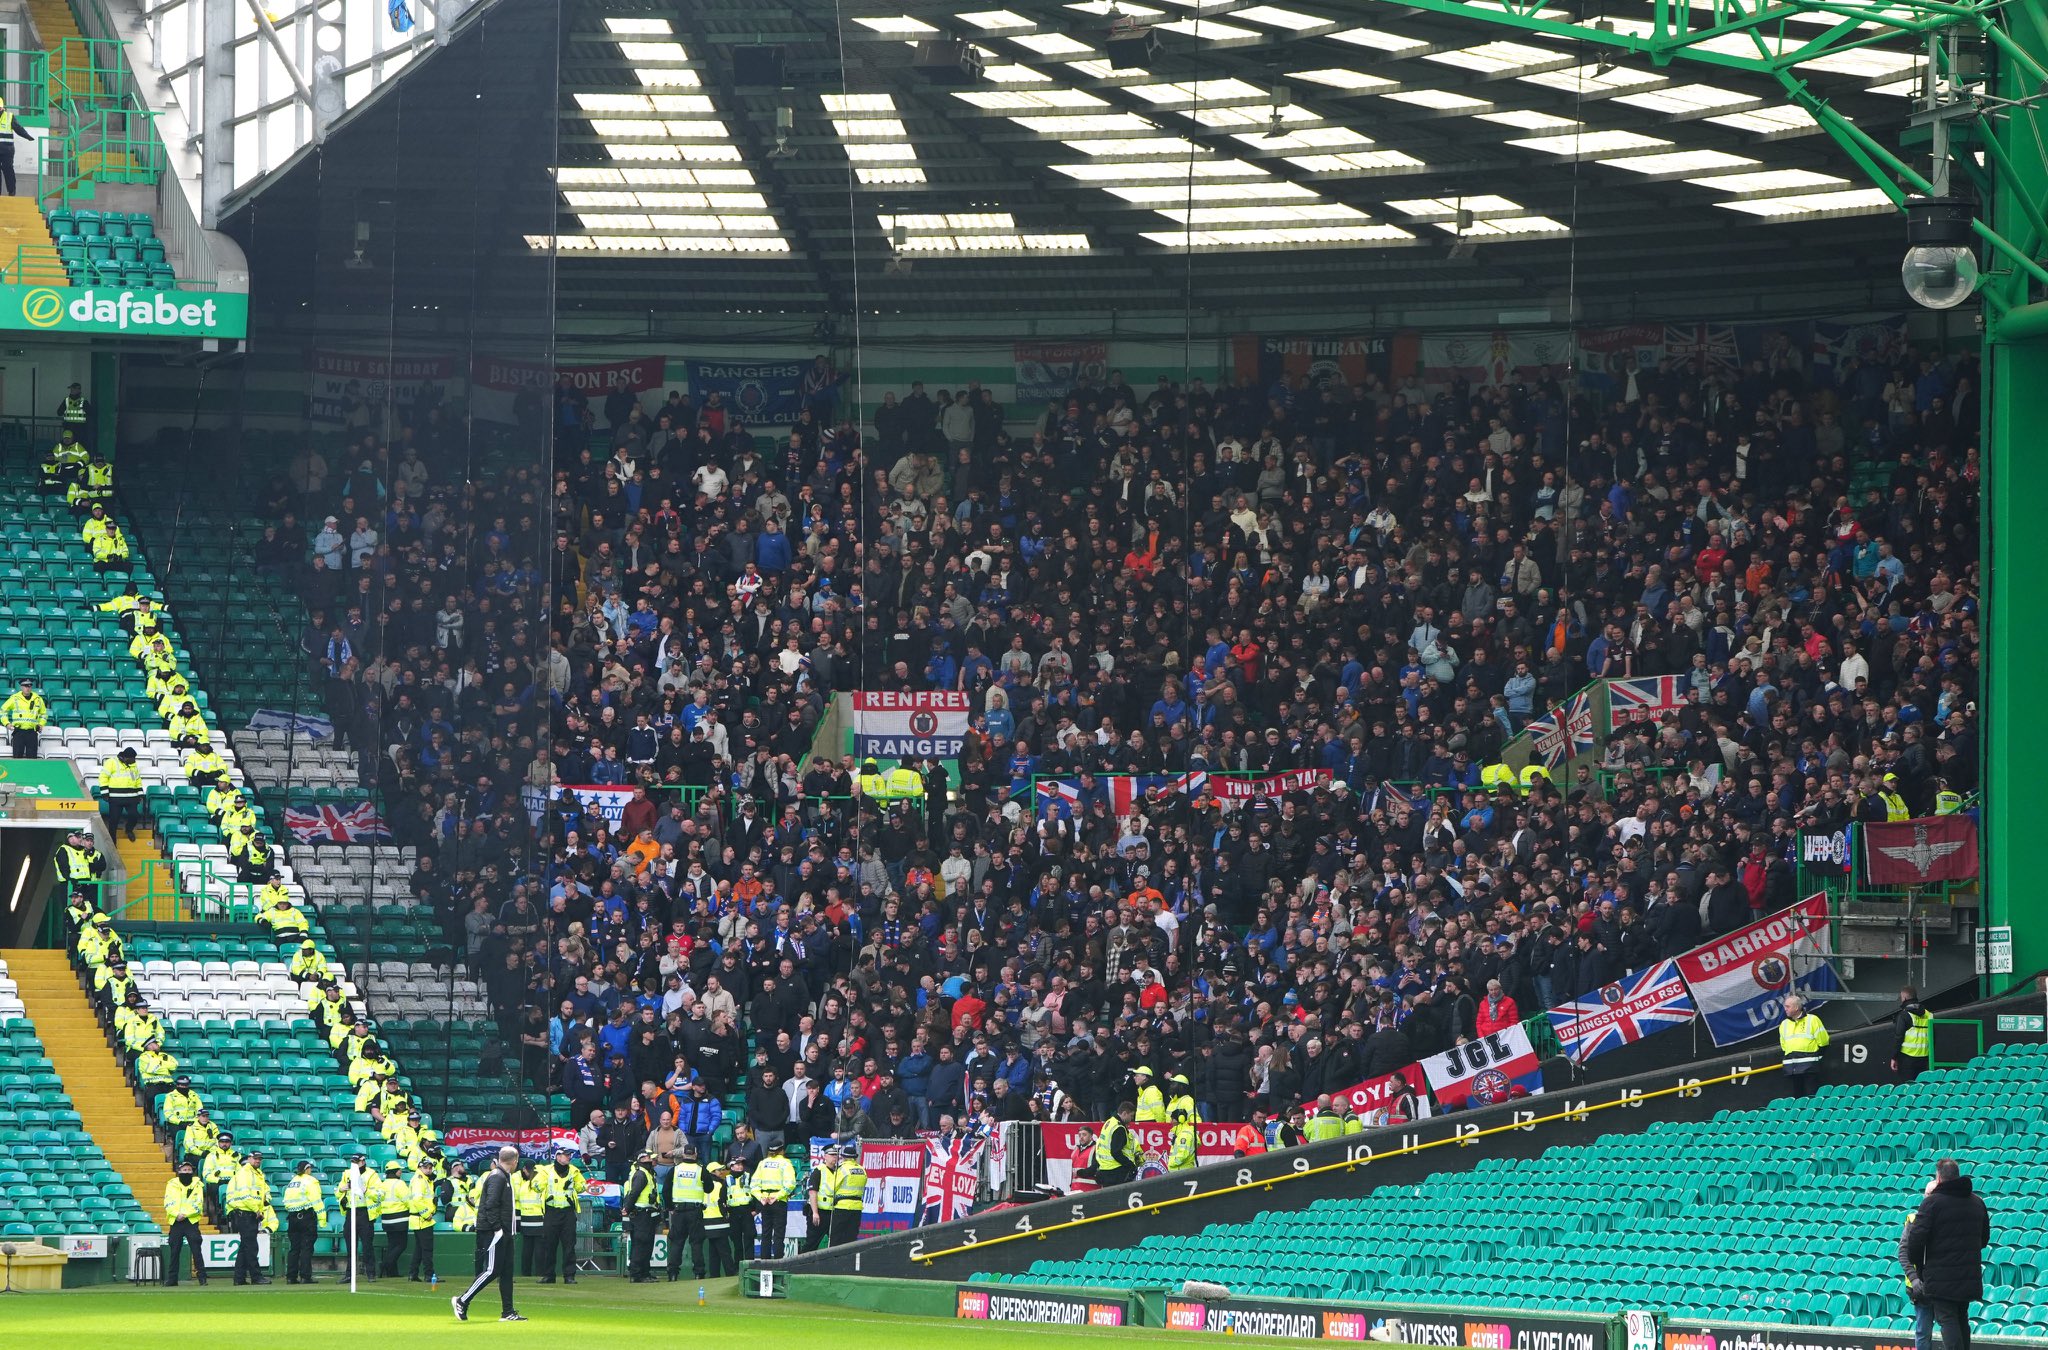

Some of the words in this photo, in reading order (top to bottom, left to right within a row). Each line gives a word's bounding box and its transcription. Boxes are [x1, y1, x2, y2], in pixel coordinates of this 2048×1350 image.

[69, 290, 217, 329] dafabet
[1265, 339, 1386, 356] SOUTHBANK
[318, 357, 360, 373] EVERY
[367, 361, 440, 376] SATURDAY
[698, 365, 800, 379] RANGERS
[867, 739, 964, 755] RANGER
[1698, 908, 1811, 973] BARROW
[1558, 1004, 1633, 1040] UDDINGSTON
[1634, 995, 1657, 1011] No1
[1658, 984, 1682, 1000] RSC
[1445, 1032, 1514, 1079] JGL
[1844, 1044, 1868, 1064] 19
[1730, 1066, 1752, 1085] 17
[1678, 1078, 1702, 1098] 16
[1621, 1088, 1644, 1108] 15
[1565, 1100, 1589, 1122] 14
[1513, 1111, 1536, 1132] 13
[449, 1129, 516, 1140] WISHAW
[1456, 1124, 1480, 1144] 12
[1403, 1134, 1419, 1154] 11
[1347, 1144, 1372, 1166] 10
[1293, 1158, 1310, 1175] 9
[1236, 1168, 1252, 1187] 8
[892, 1186, 914, 1204] BLUES
[1184, 1181, 1199, 1198] 7
[1127, 1191, 1143, 1210] 6
[1072, 1204, 1086, 1222] 5
[1015, 1214, 1033, 1232] 4
[962, 1229, 978, 1246] 3
[210, 1240, 241, 1262] E2
[910, 1239, 925, 1258] 2
[962, 1298, 981, 1312] CLYDE
[989, 1296, 1086, 1325] SUPERSCOREBOARD
[1092, 1311, 1111, 1325] CLYDE
[1171, 1311, 1195, 1327] CLYDE
[1329, 1322, 1354, 1338] CLYDE
[1471, 1332, 1499, 1349] CLYDE
